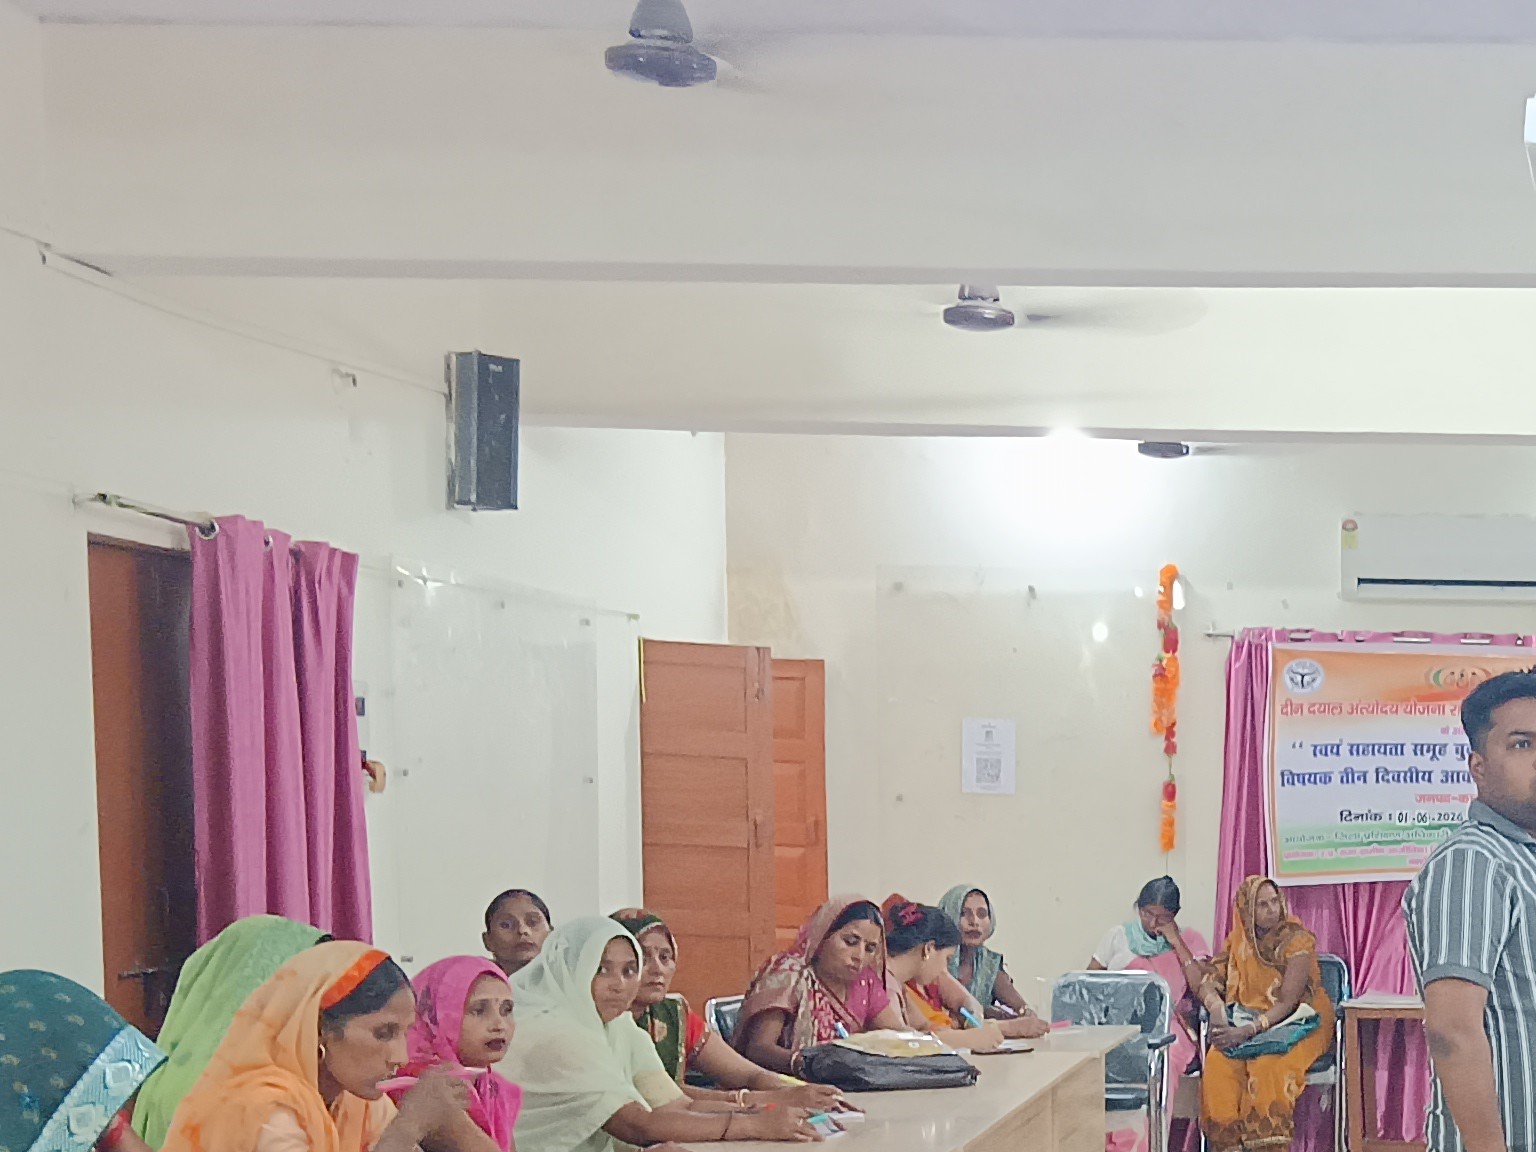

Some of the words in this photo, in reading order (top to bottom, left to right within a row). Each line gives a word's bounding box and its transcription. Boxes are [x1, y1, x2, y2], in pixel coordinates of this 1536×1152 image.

[1281, 699, 1303, 716] दीन
[1308, 702, 1342, 716] दयाल
[1403, 699, 1446, 716] योजना
[1348, 743, 1405, 757] सहायता
[1411, 743, 1449, 761] समूह
[1281, 770, 1333, 787] विषयक
[1339, 767, 1368, 784] तीन
[1375, 767, 1434, 784] दिवसीय
[1340, 809, 1383, 823] दिनांक
